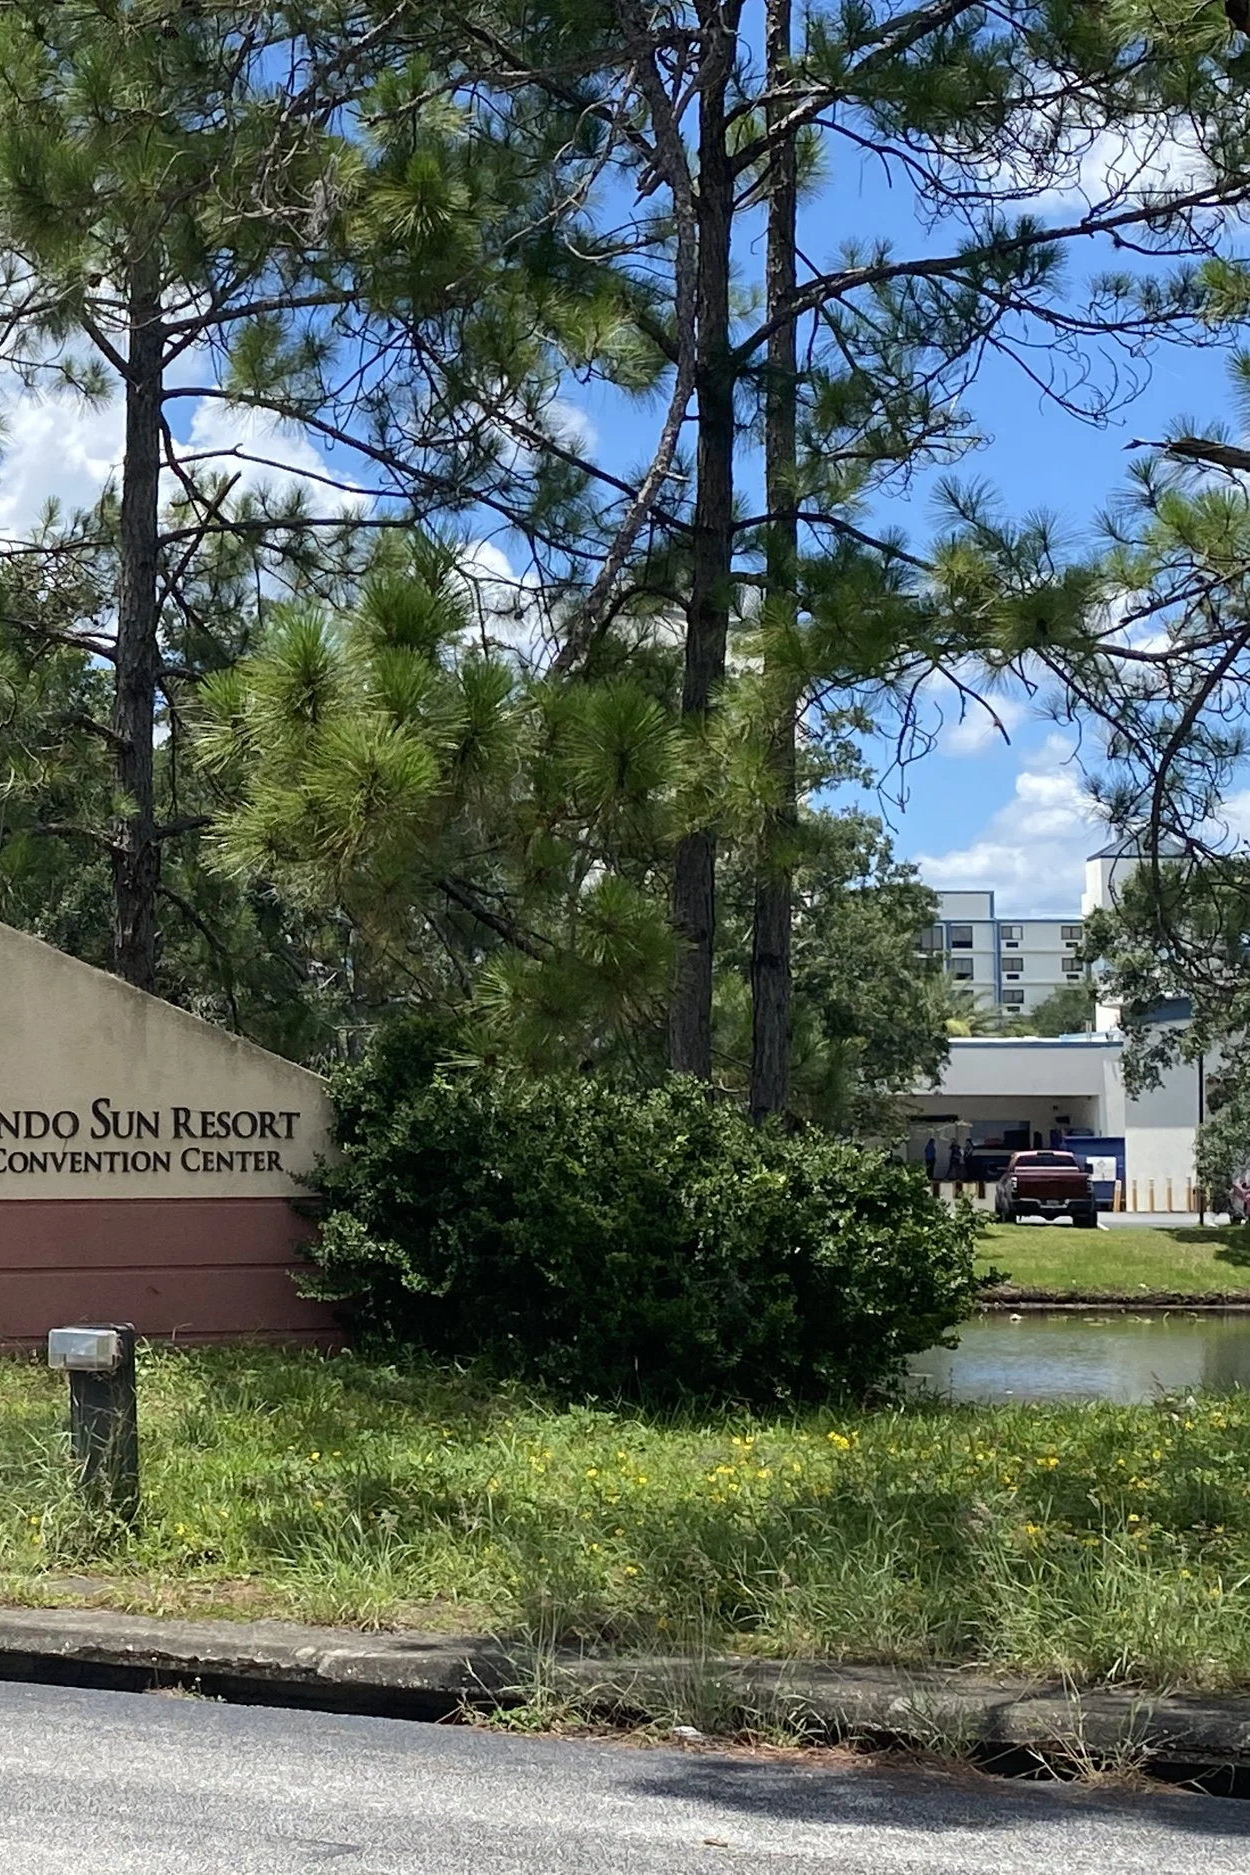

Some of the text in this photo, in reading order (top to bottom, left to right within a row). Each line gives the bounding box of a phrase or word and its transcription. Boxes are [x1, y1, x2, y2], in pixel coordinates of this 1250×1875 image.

[90, 1098, 160, 1140] SUN
[170, 1107, 300, 1140] RESORT
[180, 1147, 284, 1172] CENTER
